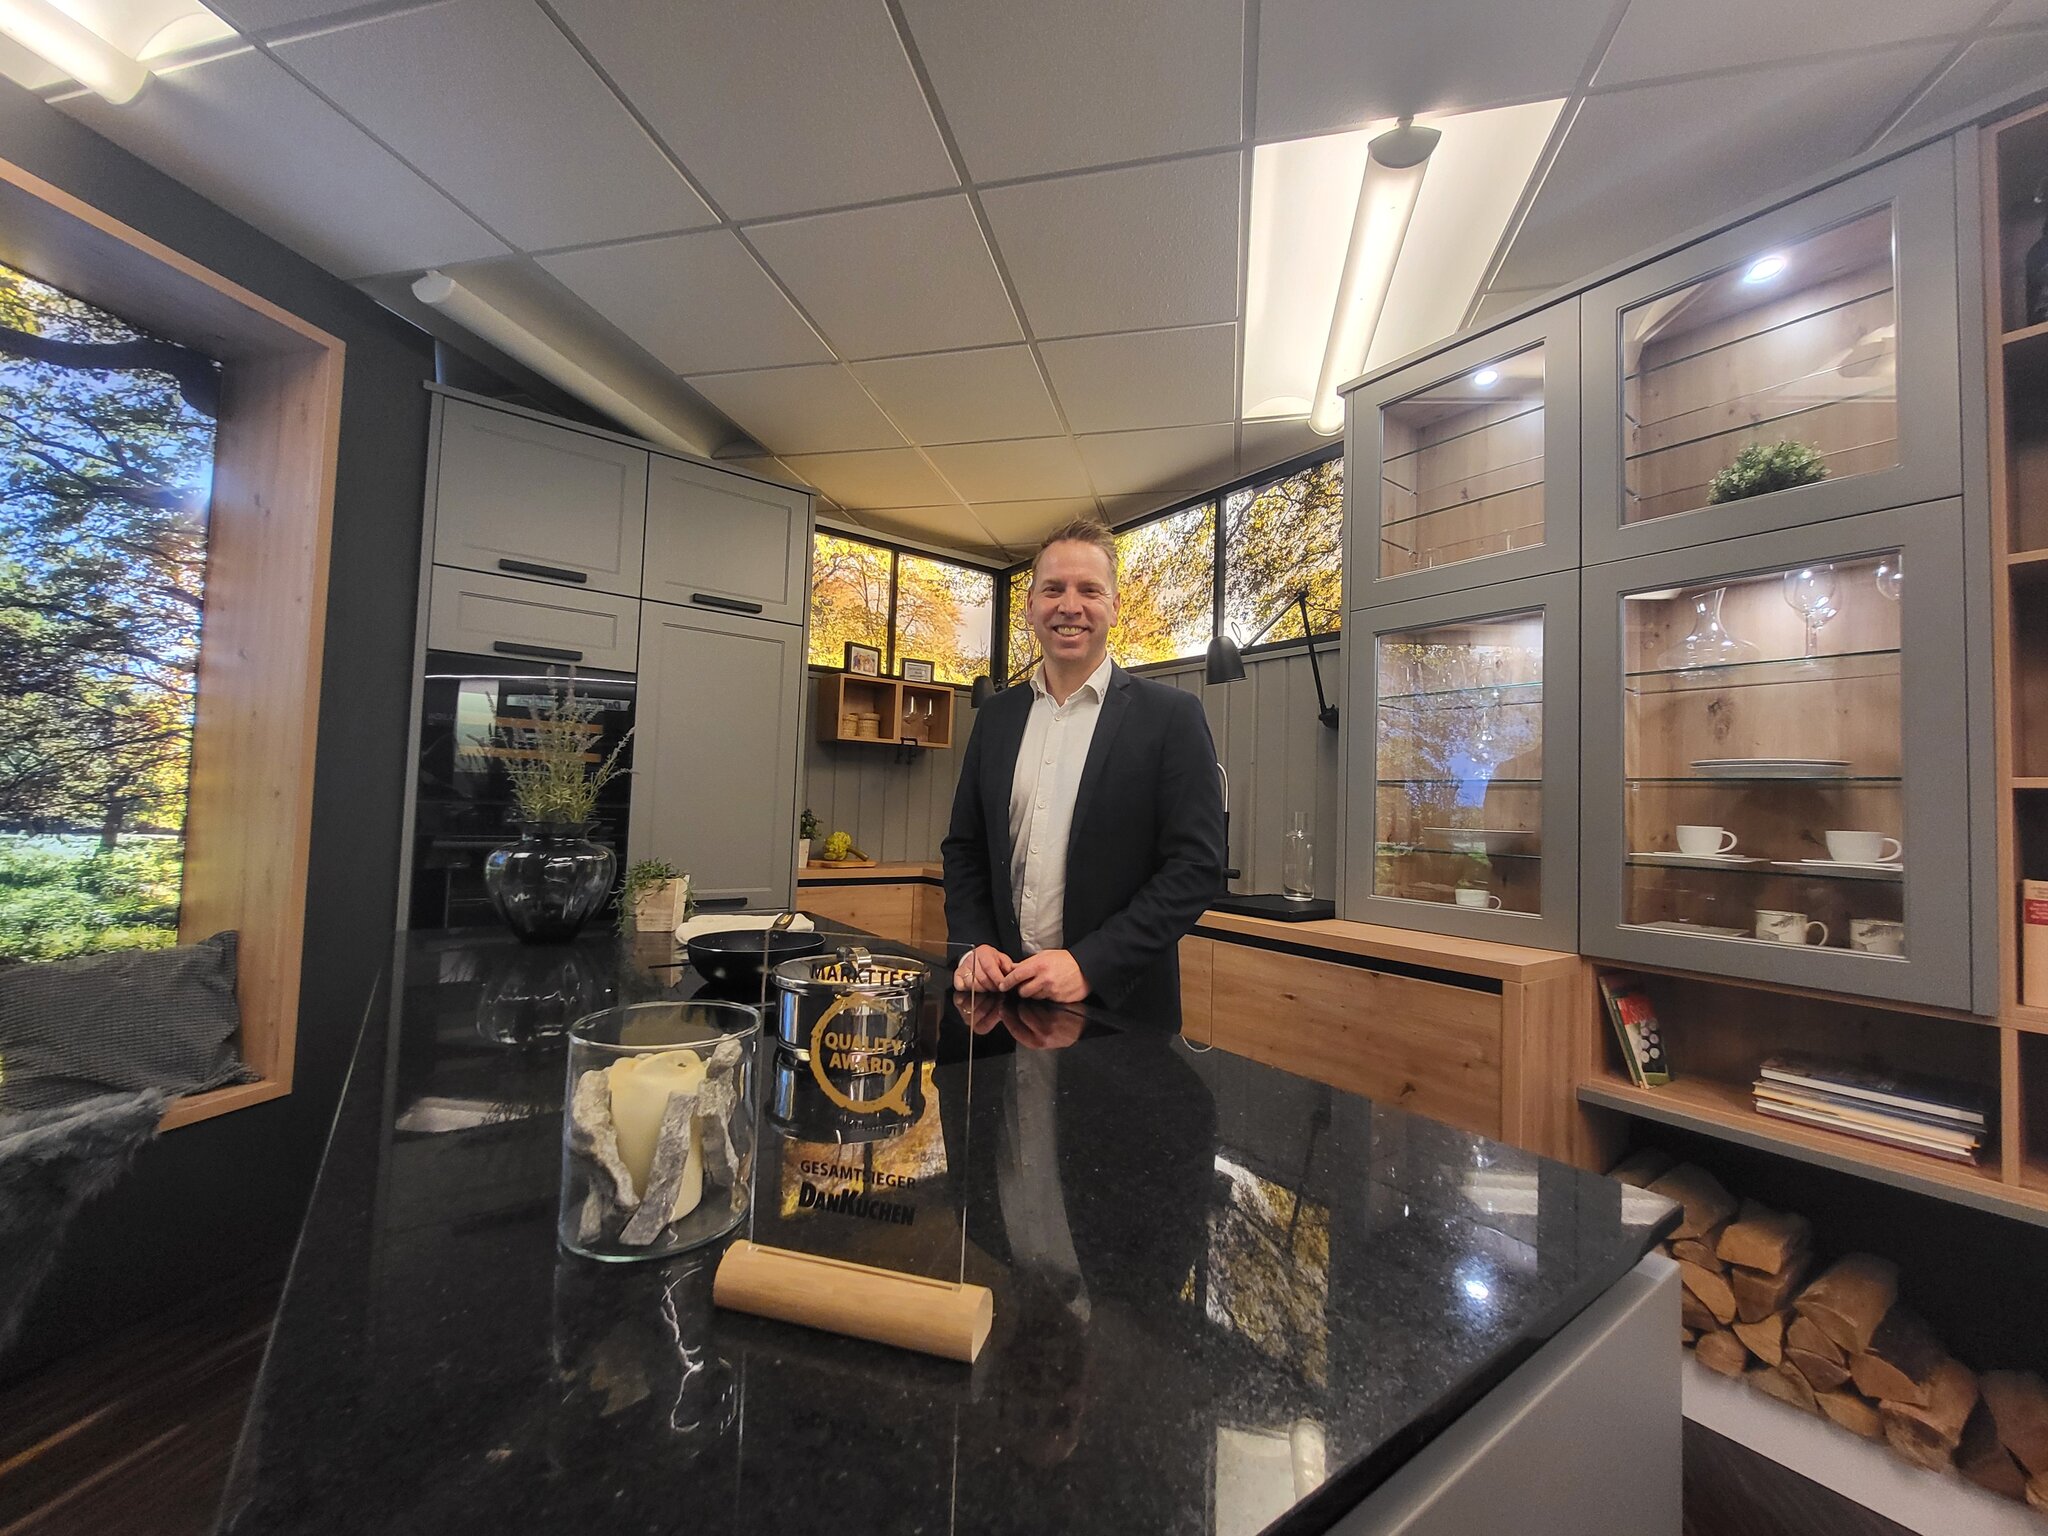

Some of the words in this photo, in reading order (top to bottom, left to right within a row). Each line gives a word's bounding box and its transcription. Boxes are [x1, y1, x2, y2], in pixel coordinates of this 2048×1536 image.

[810, 963, 925, 989] MARKTTEST
[825, 1032, 904, 1056] QUALITY
[829, 1052, 895, 1075] AWARD
[801, 1160, 916, 1189] GESAMTSIEGER
